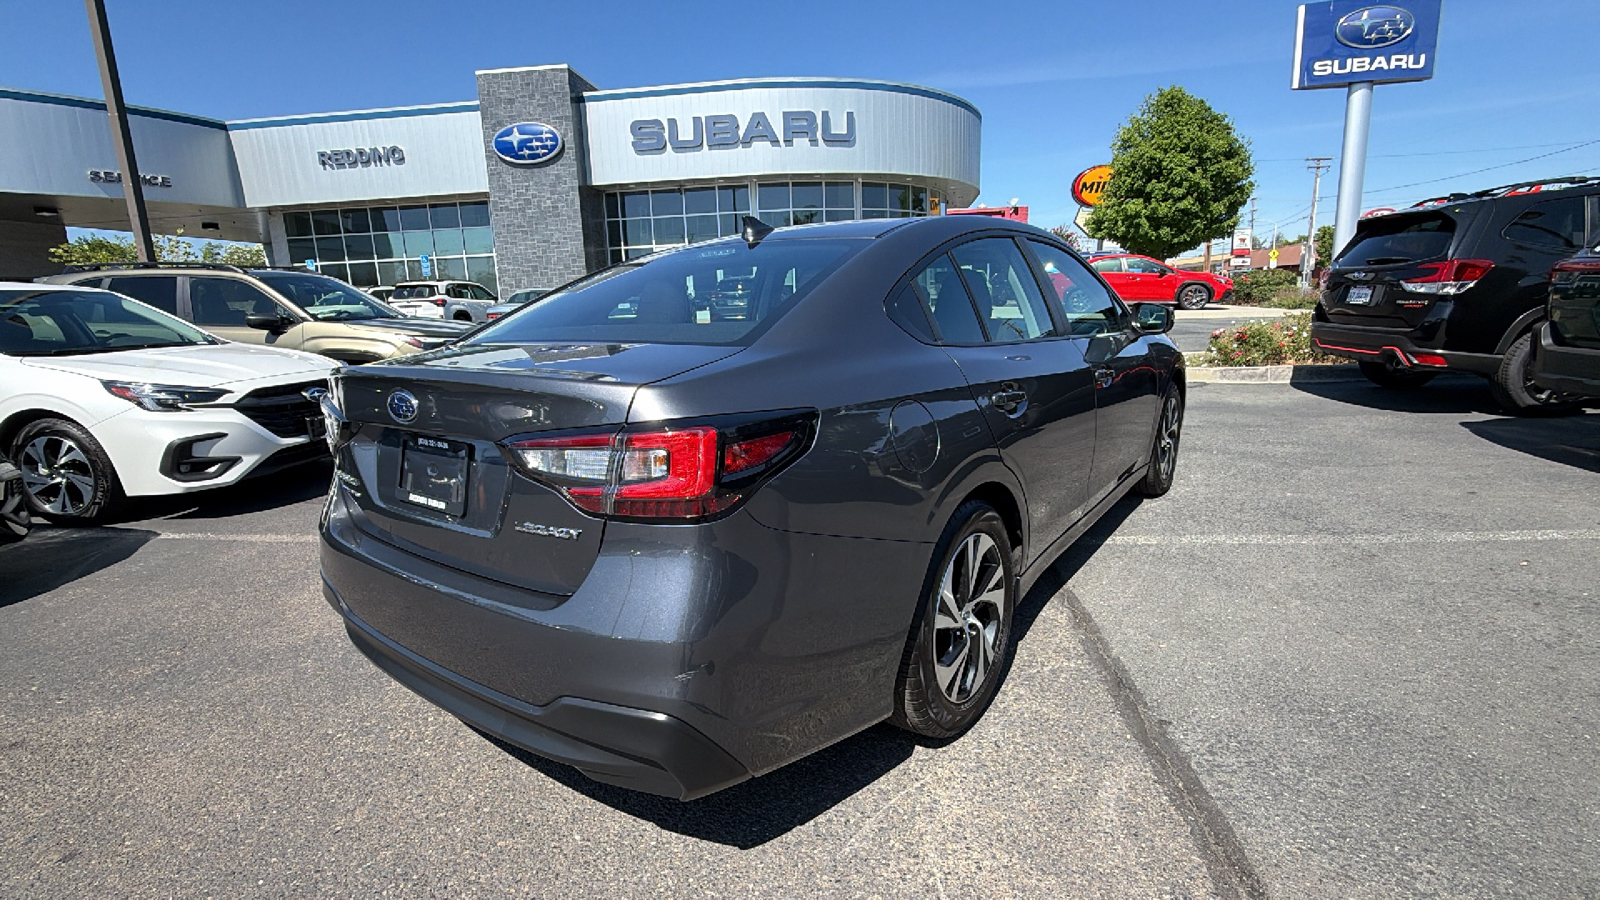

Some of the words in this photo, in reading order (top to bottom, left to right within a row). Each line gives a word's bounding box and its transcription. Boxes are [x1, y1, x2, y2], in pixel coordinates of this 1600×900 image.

[1313, 54, 1426, 75] SUBARU
[630, 111, 856, 153] SUBARU
[317, 146, 405, 169] REDDING
[89, 170, 172, 187] SEICE
